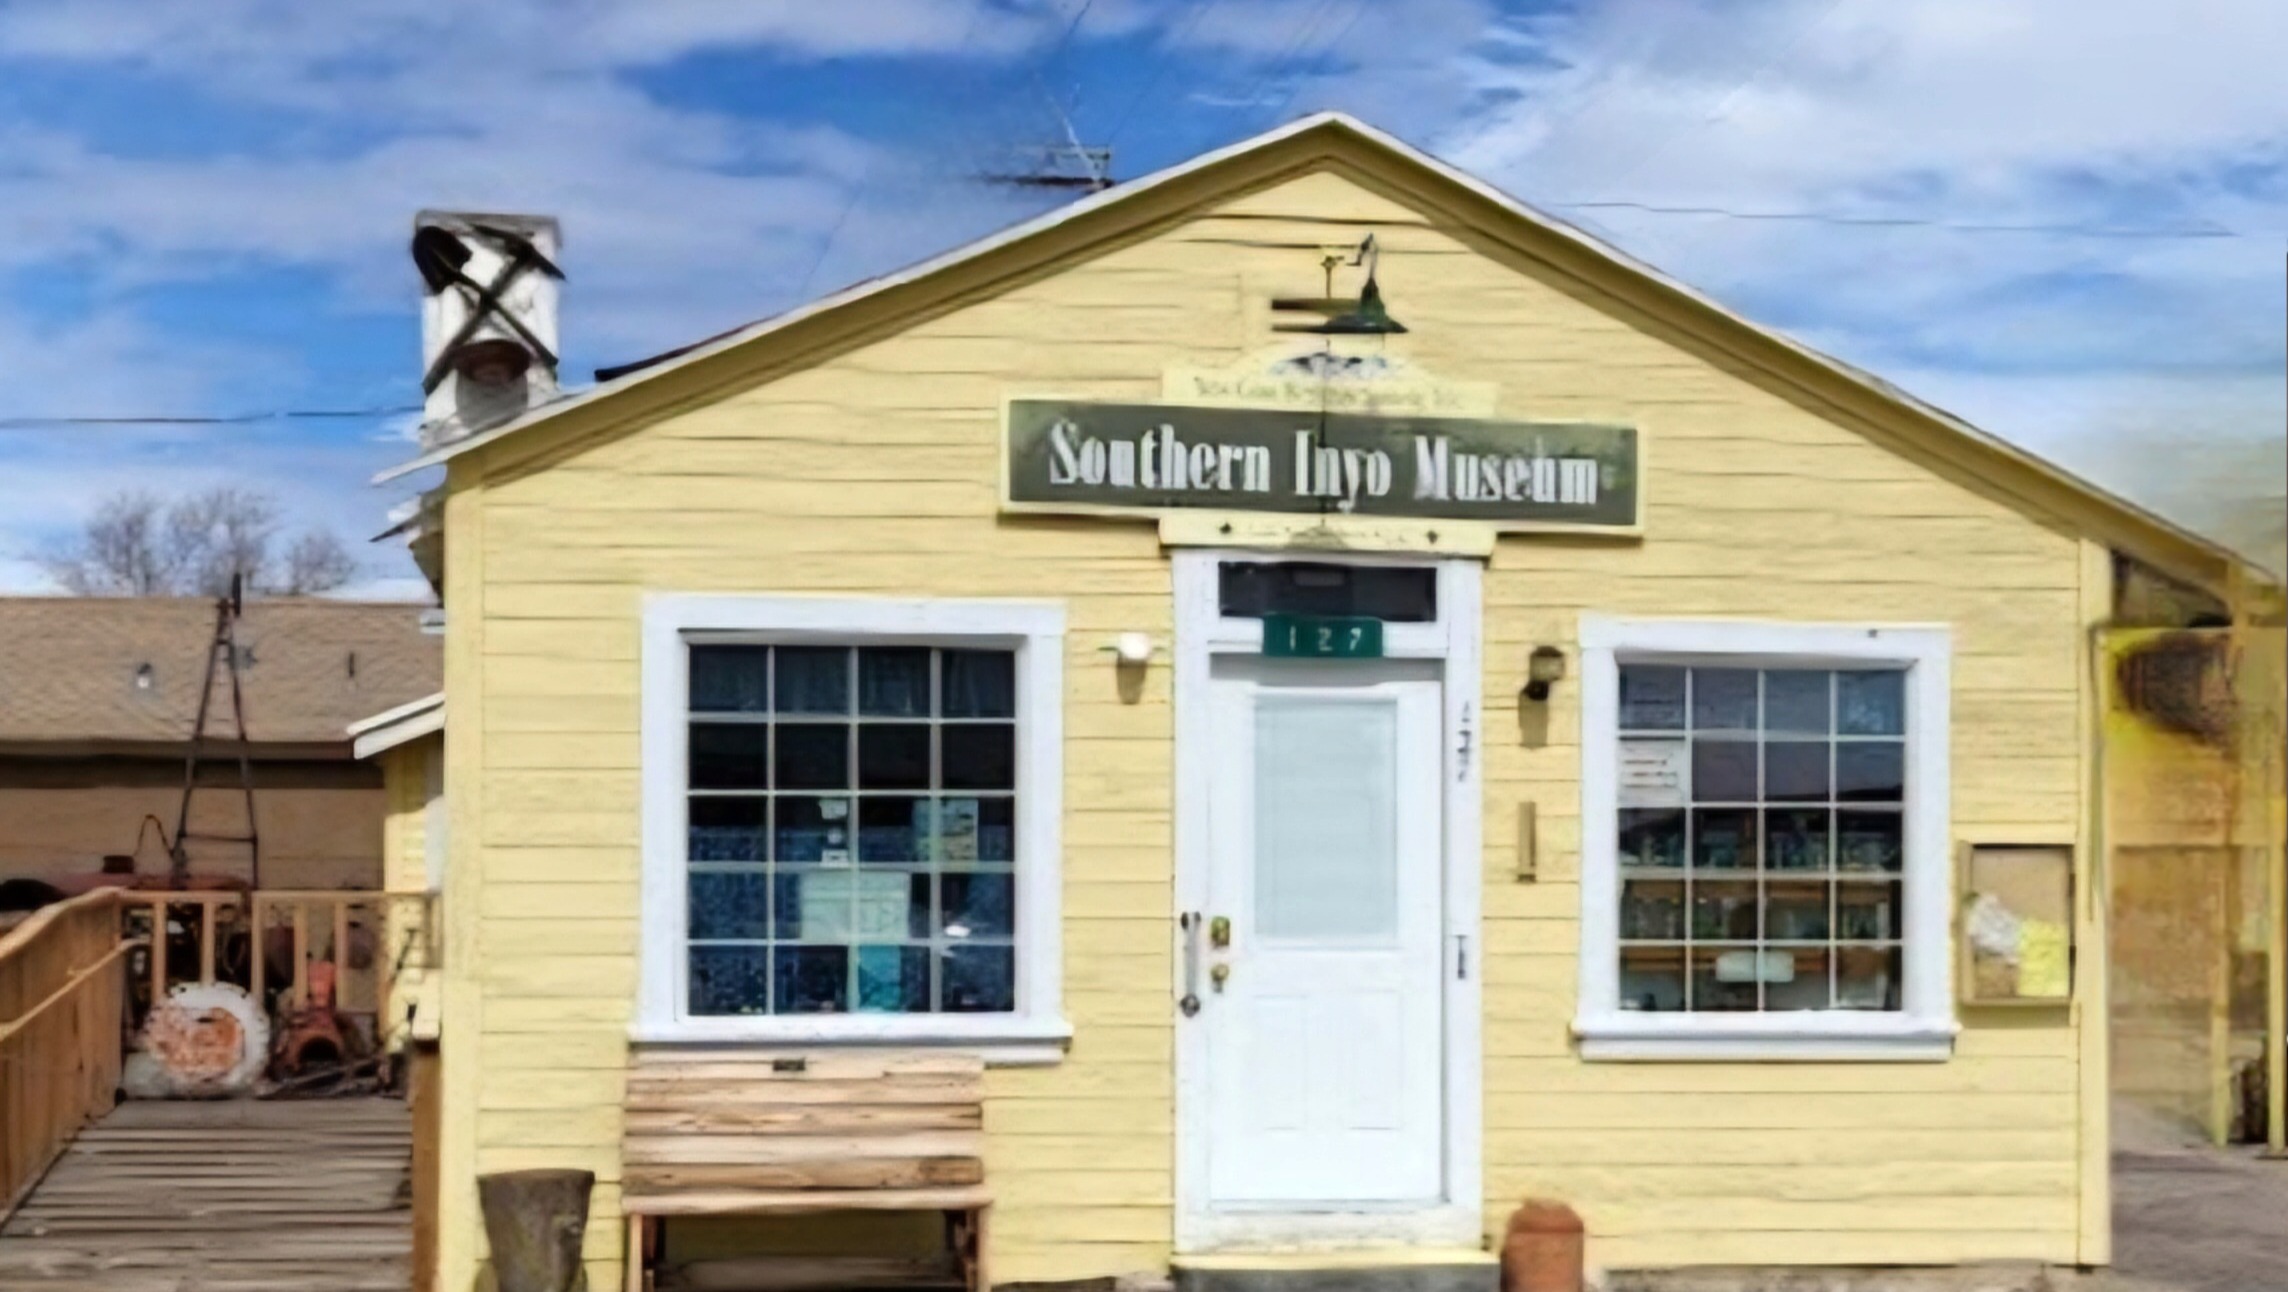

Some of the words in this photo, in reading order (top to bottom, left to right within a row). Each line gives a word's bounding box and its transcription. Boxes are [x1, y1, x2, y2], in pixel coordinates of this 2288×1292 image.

[1049, 419, 1271, 492] Southern
[1295, 430, 1392, 512] Inyo
[1414, 434, 1598, 504] Museum
[1289, 625, 1363, 651] 127
